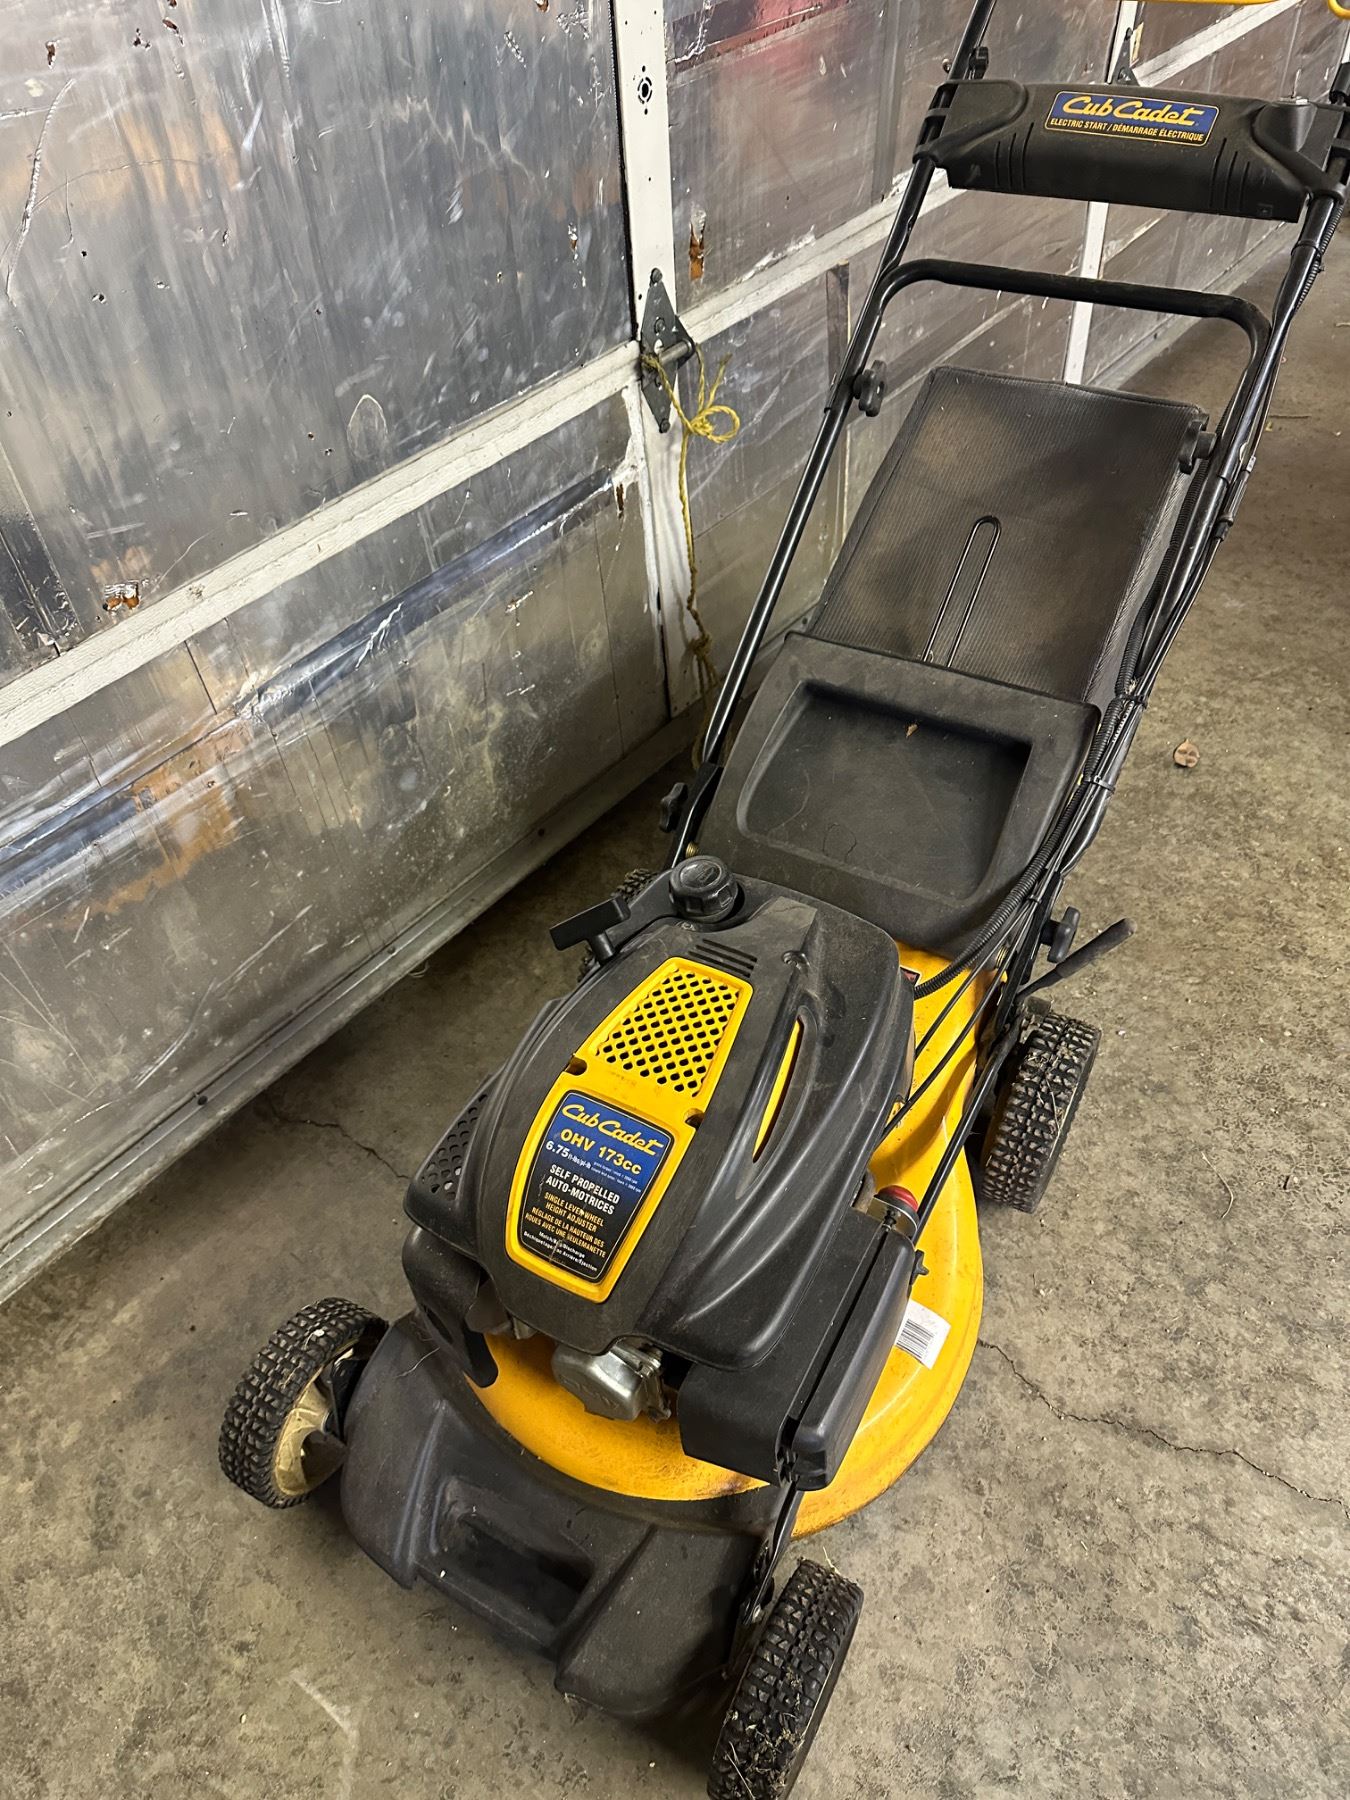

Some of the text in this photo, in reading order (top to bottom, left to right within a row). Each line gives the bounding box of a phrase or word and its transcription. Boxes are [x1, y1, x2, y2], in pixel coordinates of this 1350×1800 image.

[1063, 96, 1204, 126] Cub Cadet
[1051, 119, 1084, 128] ELECTRIC
[1084, 121, 1107, 131] START
[1113, 123, 1158, 136] DÉMARRAGE
[1159, 127, 1204, 141] ÉLECTRIQUE
[562, 1104, 664, 1155] Cub Cadet
[560, 1128, 595, 1151] OHV
[599, 1146, 642, 1175] 173cc
[546, 1176, 615, 1215] AUTO-MOTRICES
[550, 1164, 571, 1179] SELF
[572, 1174, 620, 1204] PROPELLED
[525, 1212, 541, 1226] ROUES
[542, 1219, 555, 1232] AVEC
[555, 1226, 566, 1237] UNE
[544, 1192, 604, 1226] SINGLE LEVER WHEEL
[545, 1202, 597, 1232] HEIGHT ADJUSTER
[562, 1222, 569, 1230] LA
[569, 1224, 594, 1241] HAUTEUR
[593, 1236, 604, 1248] DES
